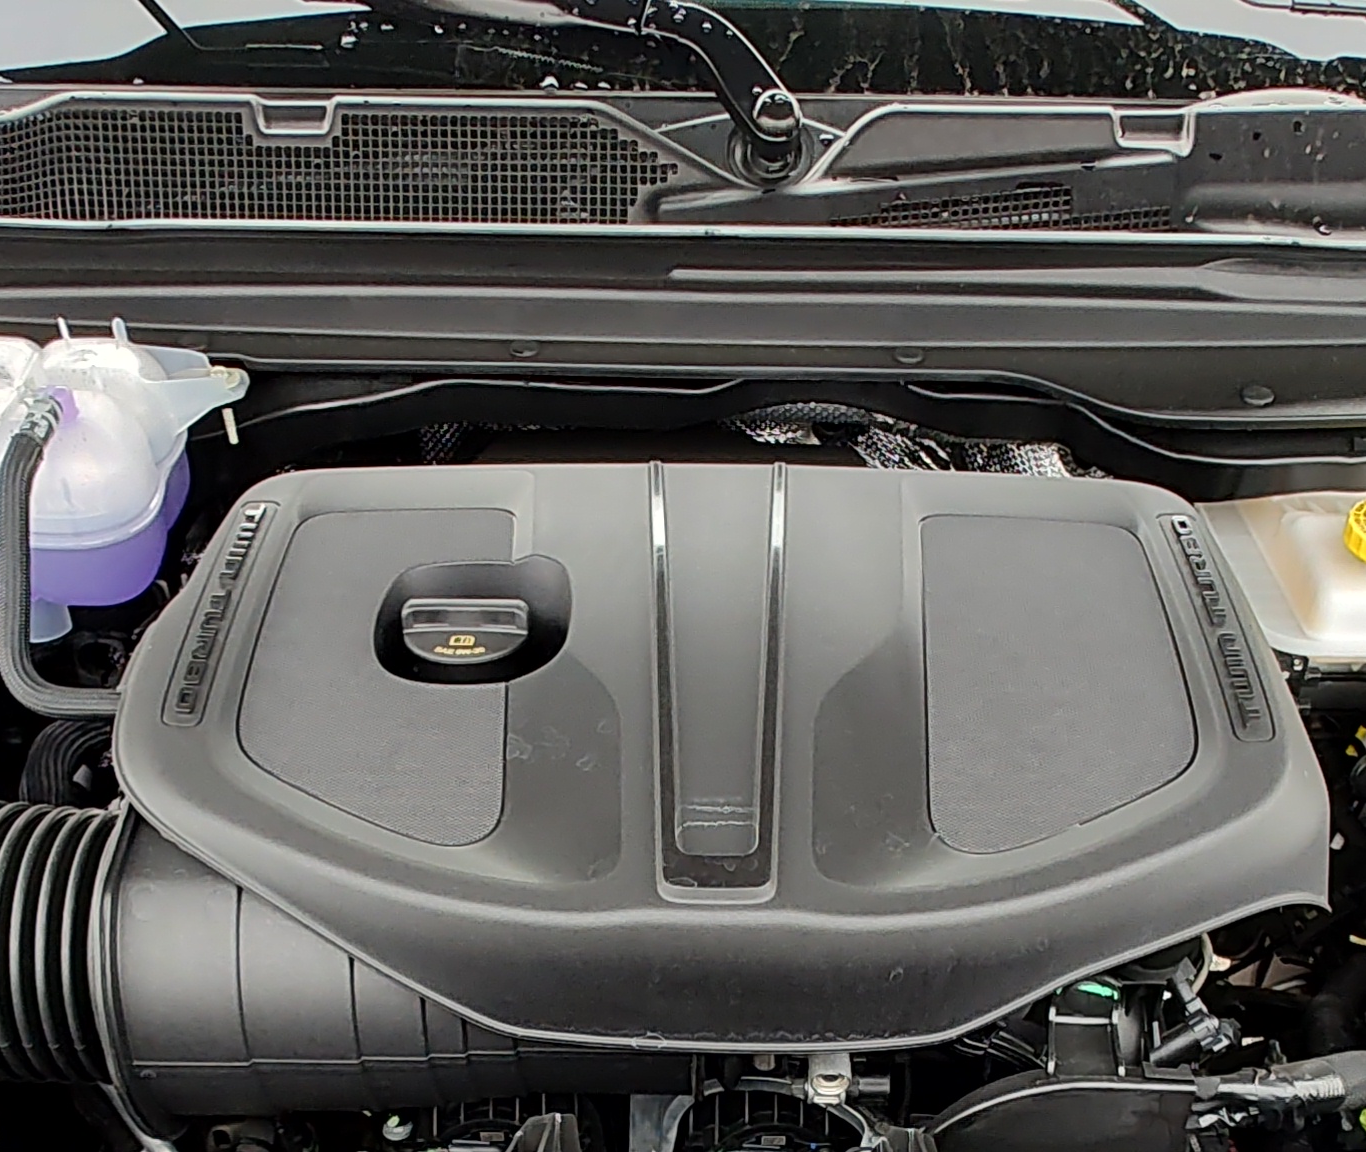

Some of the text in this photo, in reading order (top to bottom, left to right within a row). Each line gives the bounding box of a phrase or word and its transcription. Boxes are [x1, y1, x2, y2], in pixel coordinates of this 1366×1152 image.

[175, 503, 267, 715] TWIN TURBO
[1171, 515, 1262, 730] TWIN TURBO
